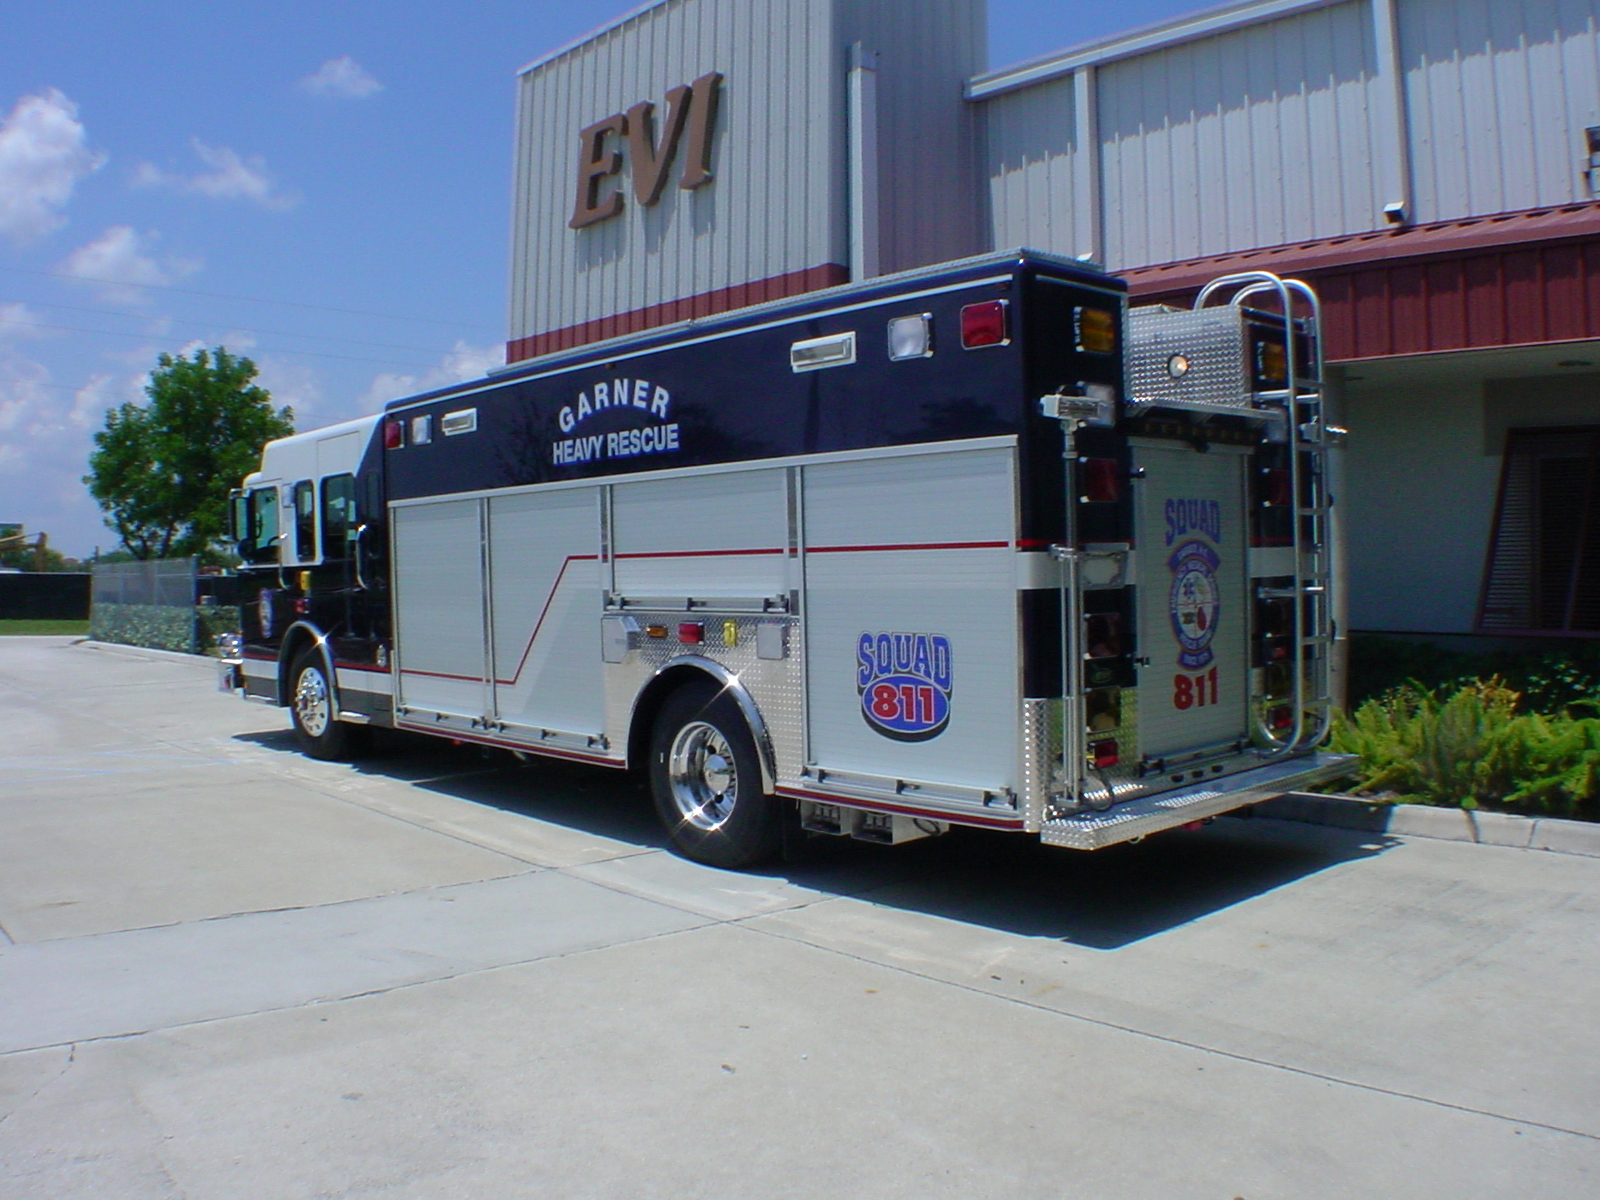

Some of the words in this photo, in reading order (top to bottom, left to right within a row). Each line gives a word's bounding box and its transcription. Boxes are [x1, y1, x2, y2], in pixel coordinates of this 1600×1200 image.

[568, 71, 724, 230] EVI
[559, 378, 669, 433] GARNER
[553, 434, 603, 464] HEAVY
[607, 423, 679, 457] RESCUE
[1165, 498, 1221, 546] SQUAD
[857, 631, 953, 693] SQUAD
[871, 683, 935, 724] 811
[1174, 666, 1218, 710] 811
